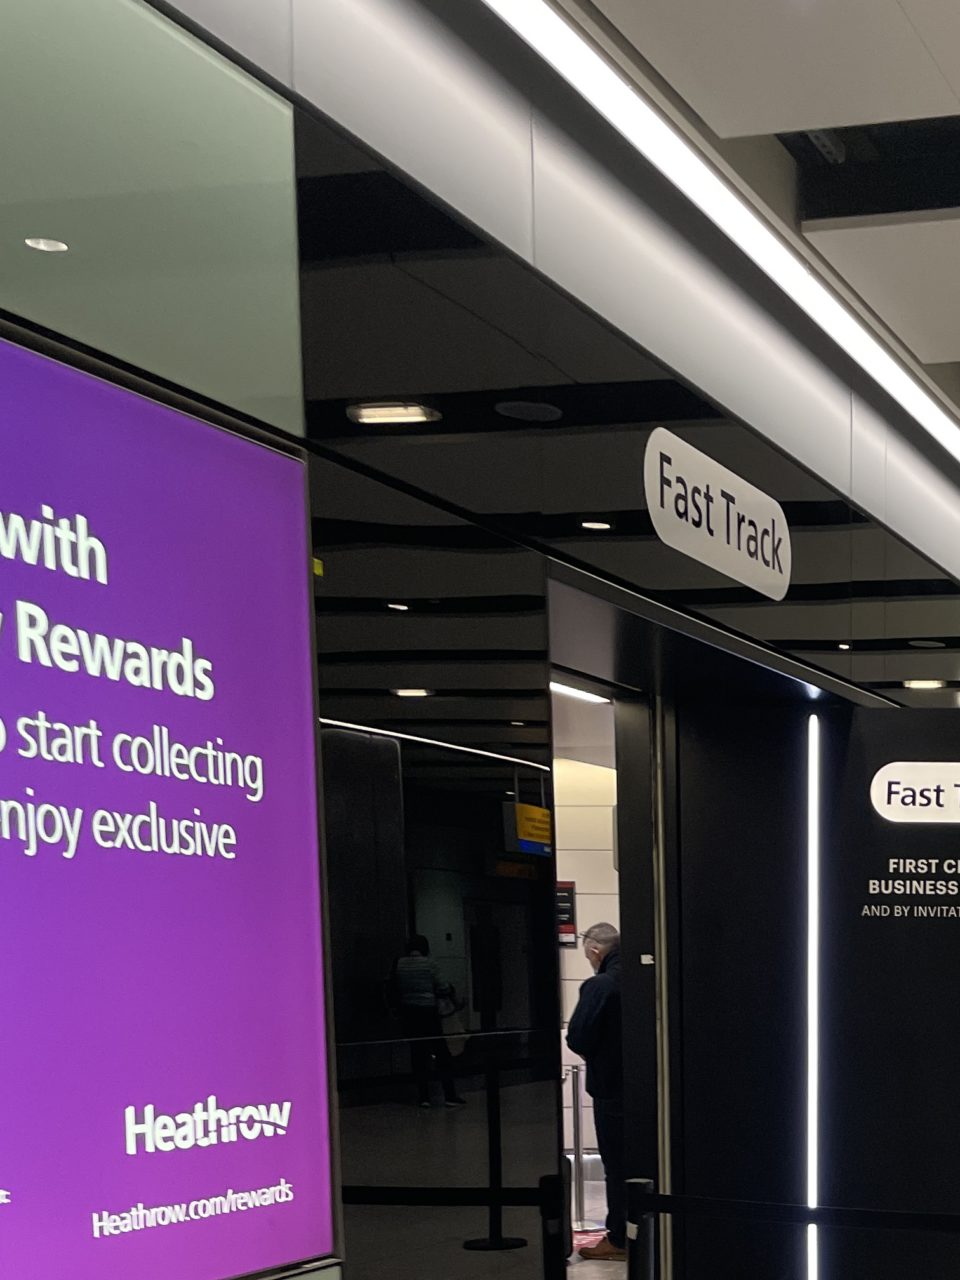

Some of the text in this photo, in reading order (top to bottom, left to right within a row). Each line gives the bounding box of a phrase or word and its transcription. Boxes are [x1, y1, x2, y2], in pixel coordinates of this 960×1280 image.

[658, 451, 785, 575] Fast Track
[0, 504, 108, 585] with
[16, 600, 215, 701] Rewards
[17, 711, 105, 768] start
[112, 725, 264, 802] collecting
[0, 787, 238, 859] njoy exclusive
[885, 780, 945, 809] Fast
[868, 879, 959, 895] BUSINESS
[888, 858, 939, 874] FIRST
[861, 905, 890, 917] AND
[894, 905, 911, 917] BY
[124, 1095, 292, 1155] Heathrow
[92, 1178, 294, 1238] Heathrow.com/rewards
